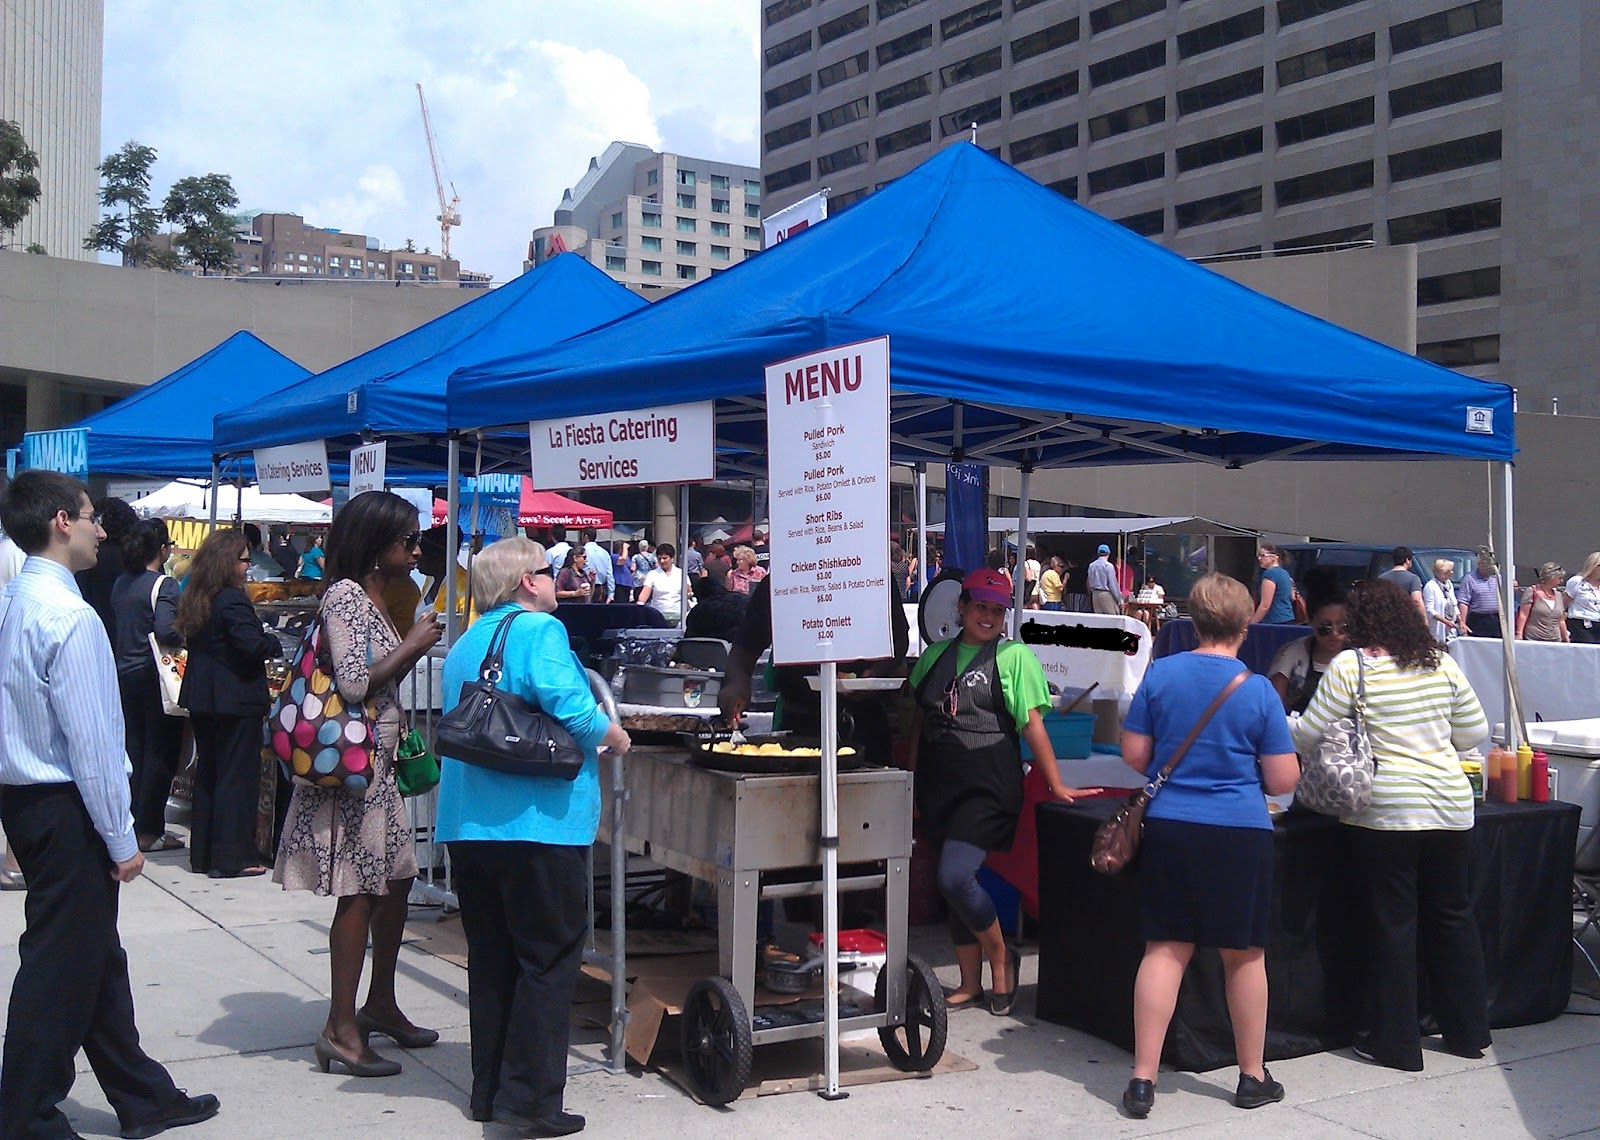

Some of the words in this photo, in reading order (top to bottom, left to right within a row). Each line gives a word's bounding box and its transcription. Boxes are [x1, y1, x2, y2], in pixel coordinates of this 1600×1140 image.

[785, 355, 862, 405] MENU
[549, 427, 562, 448] La
[565, 422, 605, 447] Fiesta
[608, 413, 678, 442] Catering
[804, 427, 825, 441] Pulled
[827, 424, 845, 437] Pork
[28, 430, 88, 473] JAMAICA
[812, 439, 835, 451] Sandwich
[354, 450, 376, 476] MENU
[815, 450, 831, 461] $5.00
[268, 462, 290, 482] Catering
[291, 459, 323, 478] Services
[579, 455, 638, 480] Services
[804, 467, 825, 481] Pulled
[827, 464, 844, 477] Pork
[778, 488, 793, 498] Served
[794, 486, 804, 495] with
[816, 481, 832, 491] Potato
[857, 475, 876, 485] Onions
[815, 492, 831, 503] $6.00
[543, 515, 573, 524] Scenic
[574, 516, 602, 525] Acres
[805, 512, 825, 525] Short
[826, 510, 843, 521] Ribs
[788, 528, 804, 538] Served
[804, 527, 814, 537] with
[828, 523, 843, 533] Beans
[849, 520, 864, 530] Salad
[816, 535, 832, 545] $6.00
[790, 561, 817, 573] Chicken
[818, 555, 862, 571] Shishkabob
[816, 571, 832, 581] $3.00
[774, 588, 789, 597] Served
[789, 586, 799, 595] with
[828, 581, 842, 591] Salad
[848, 579, 866, 589] Potato
[817, 593, 833, 603] $6.00
[802, 619, 824, 630] Potato
[825, 615, 852, 628] Omlett
[818, 630, 834, 639] $2.00
[1042, 662, 1058, 673] nted
[1060, 662, 1069, 676] by
